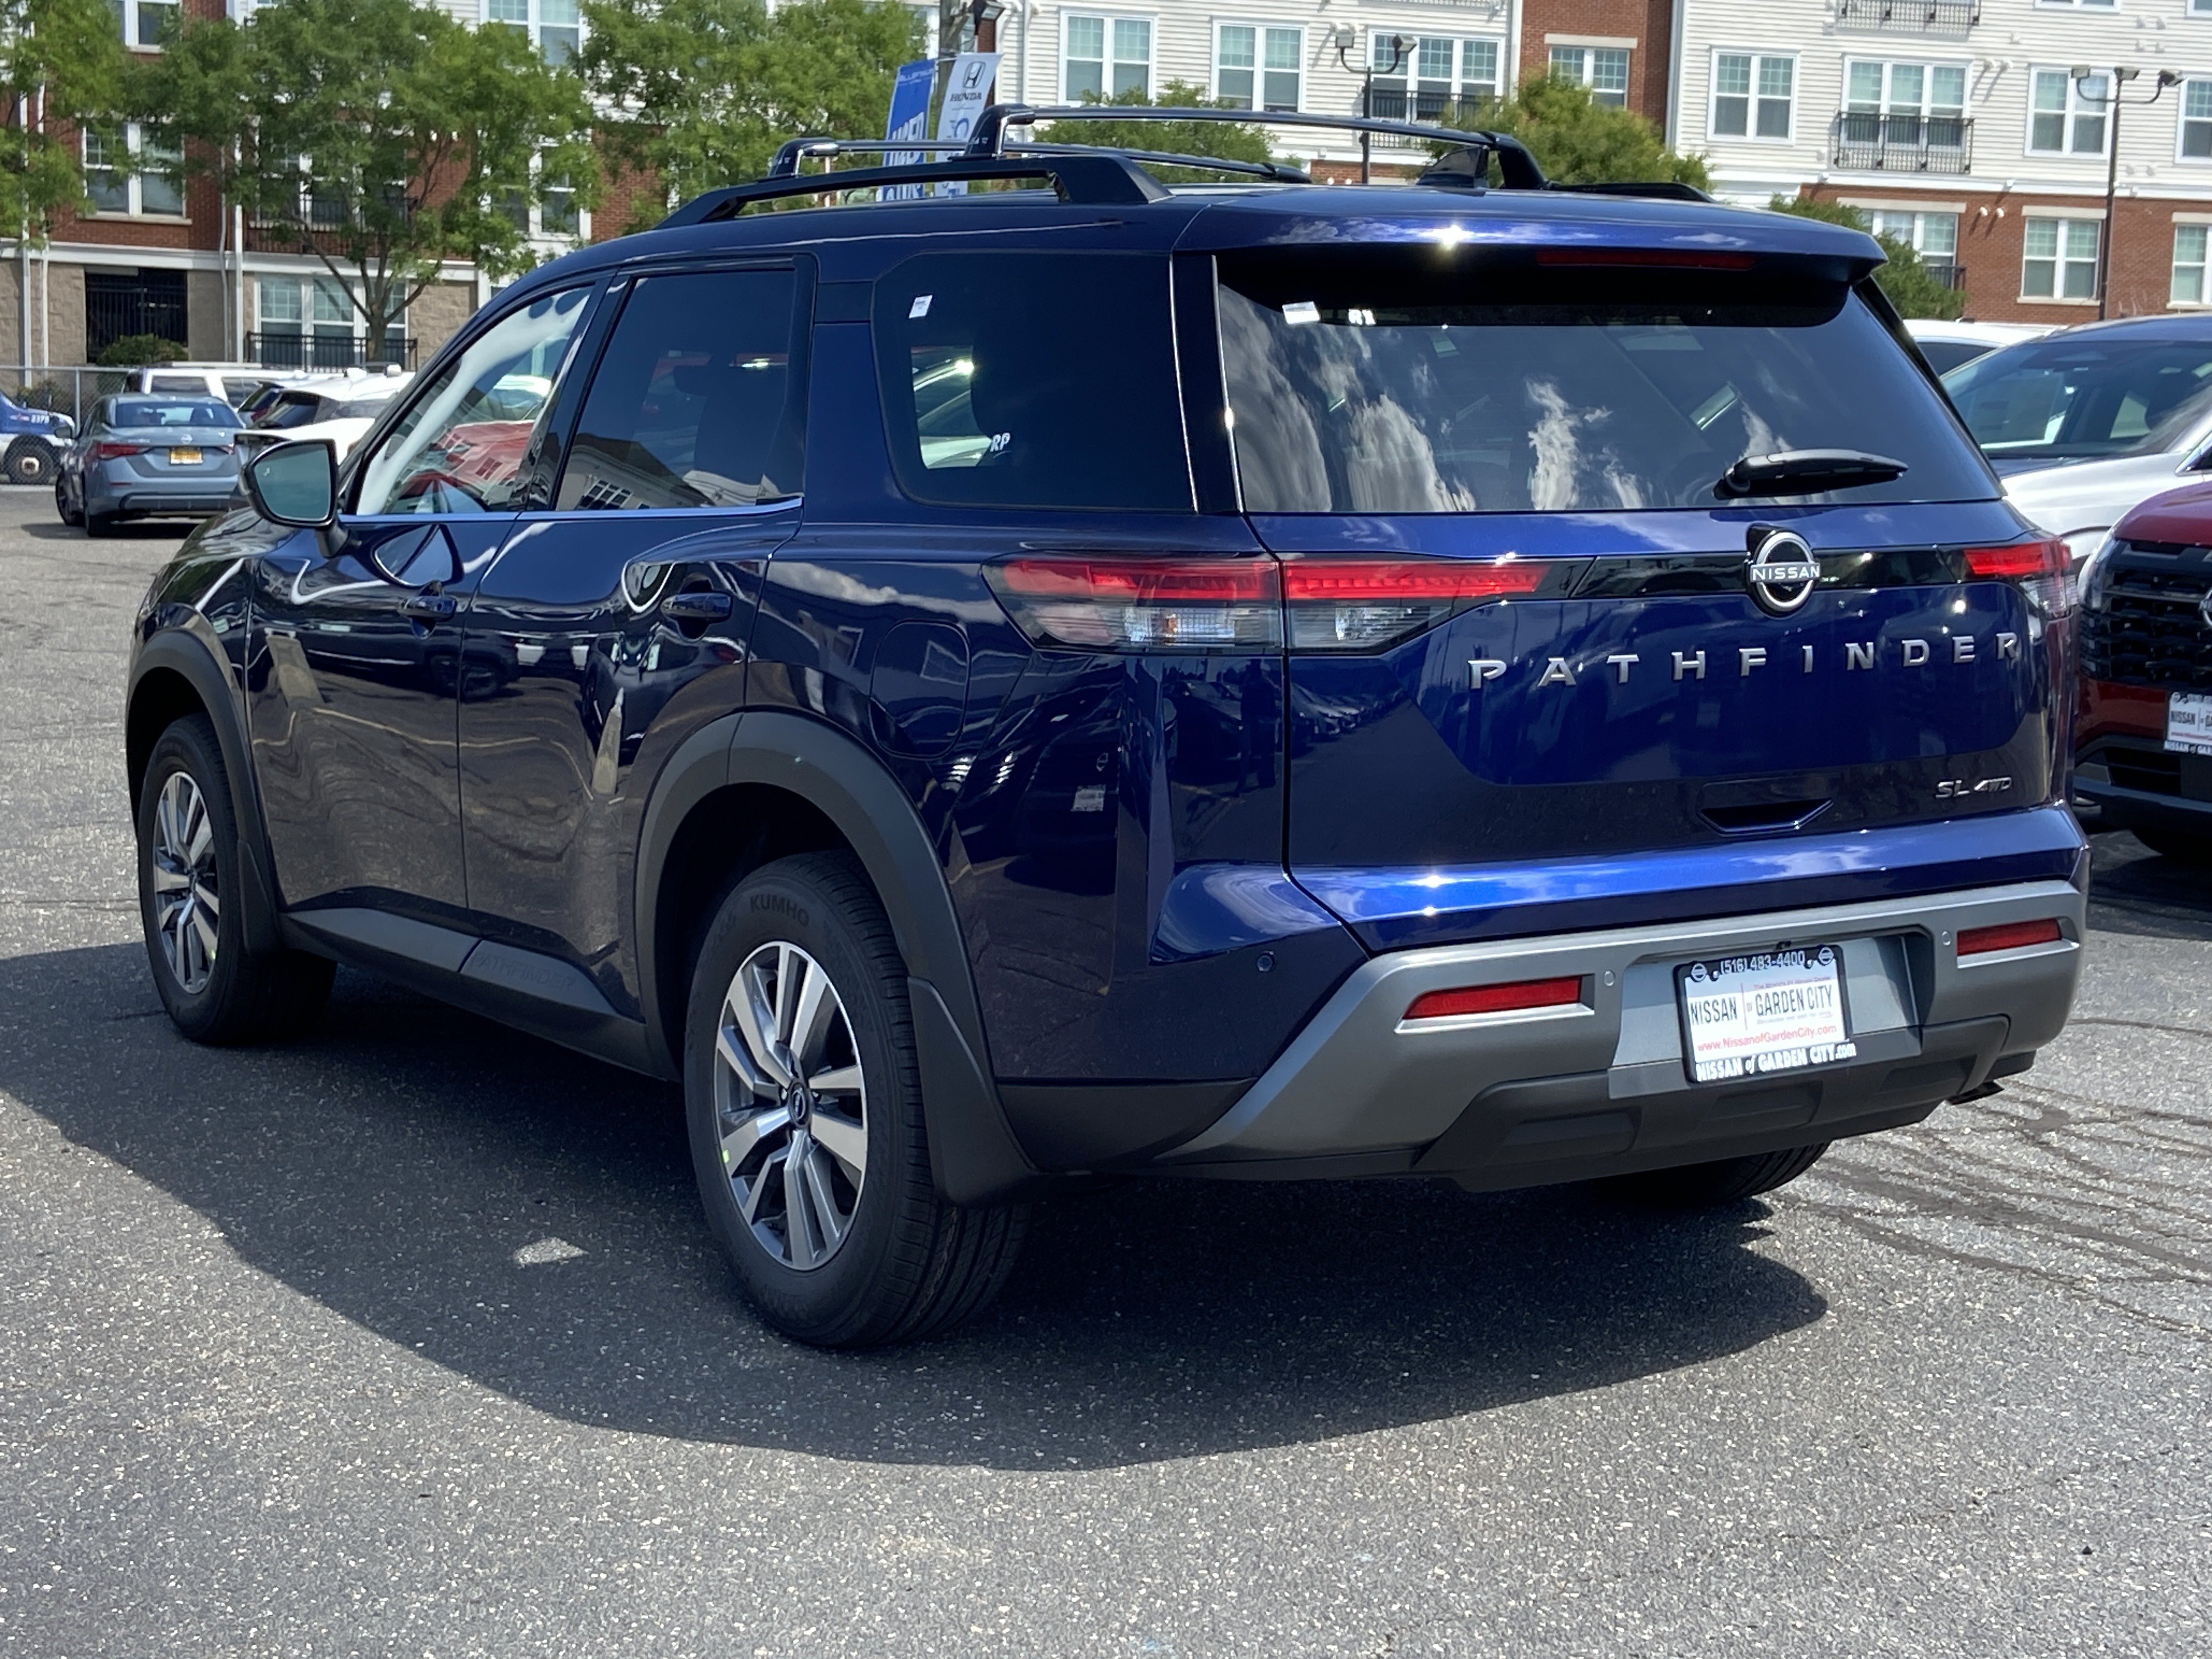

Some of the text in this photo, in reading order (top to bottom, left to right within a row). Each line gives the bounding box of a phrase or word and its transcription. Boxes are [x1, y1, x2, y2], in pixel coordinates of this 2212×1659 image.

[950, 92, 982, 101] HONDA
[1752, 566, 1820, 582] NISSAN
[1468, 631, 2018, 690] PATHFINDER
[2171, 710, 2196, 725] NISSAN
[1935, 776, 2012, 798] SL 4WD
[750, 894, 810, 927] KUMHO
[1720, 950, 1805, 975] (516) 483-4400
[1690, 996, 1737, 1025] NISSAN
[1755, 987, 1805, 1016] GARDEN
[1807, 984, 1832, 1009] CITY
[1697, 1025, 1837, 1051] www.NissanofGardenCity.com
[1696, 1057, 1743, 1082] NISSAN
[1745, 1053, 1756, 1075] of
[1758, 1047, 1808, 1072] GARDEN
